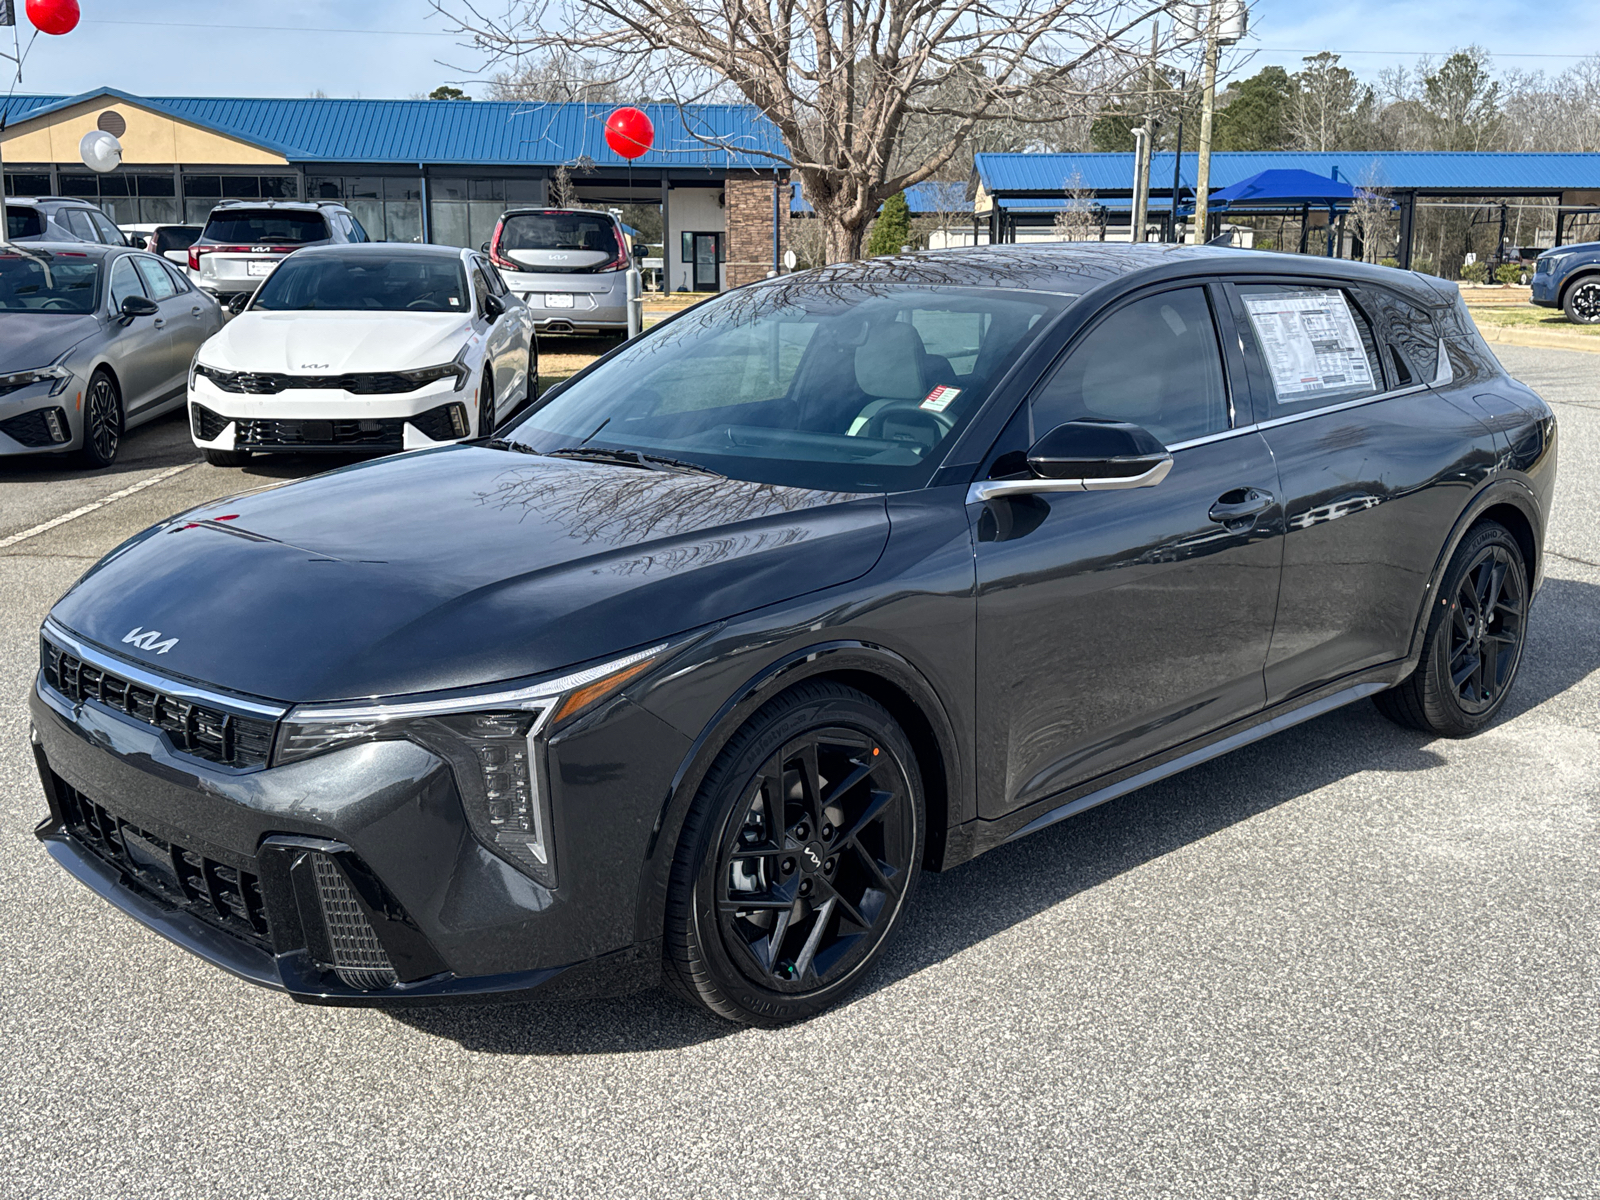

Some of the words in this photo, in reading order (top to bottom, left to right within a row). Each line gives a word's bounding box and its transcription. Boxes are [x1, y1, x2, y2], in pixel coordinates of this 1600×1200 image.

[1472, 535, 1497, 550] KUMHO
[121, 625, 179, 655] KIA
[804, 847, 821, 868] KIA
